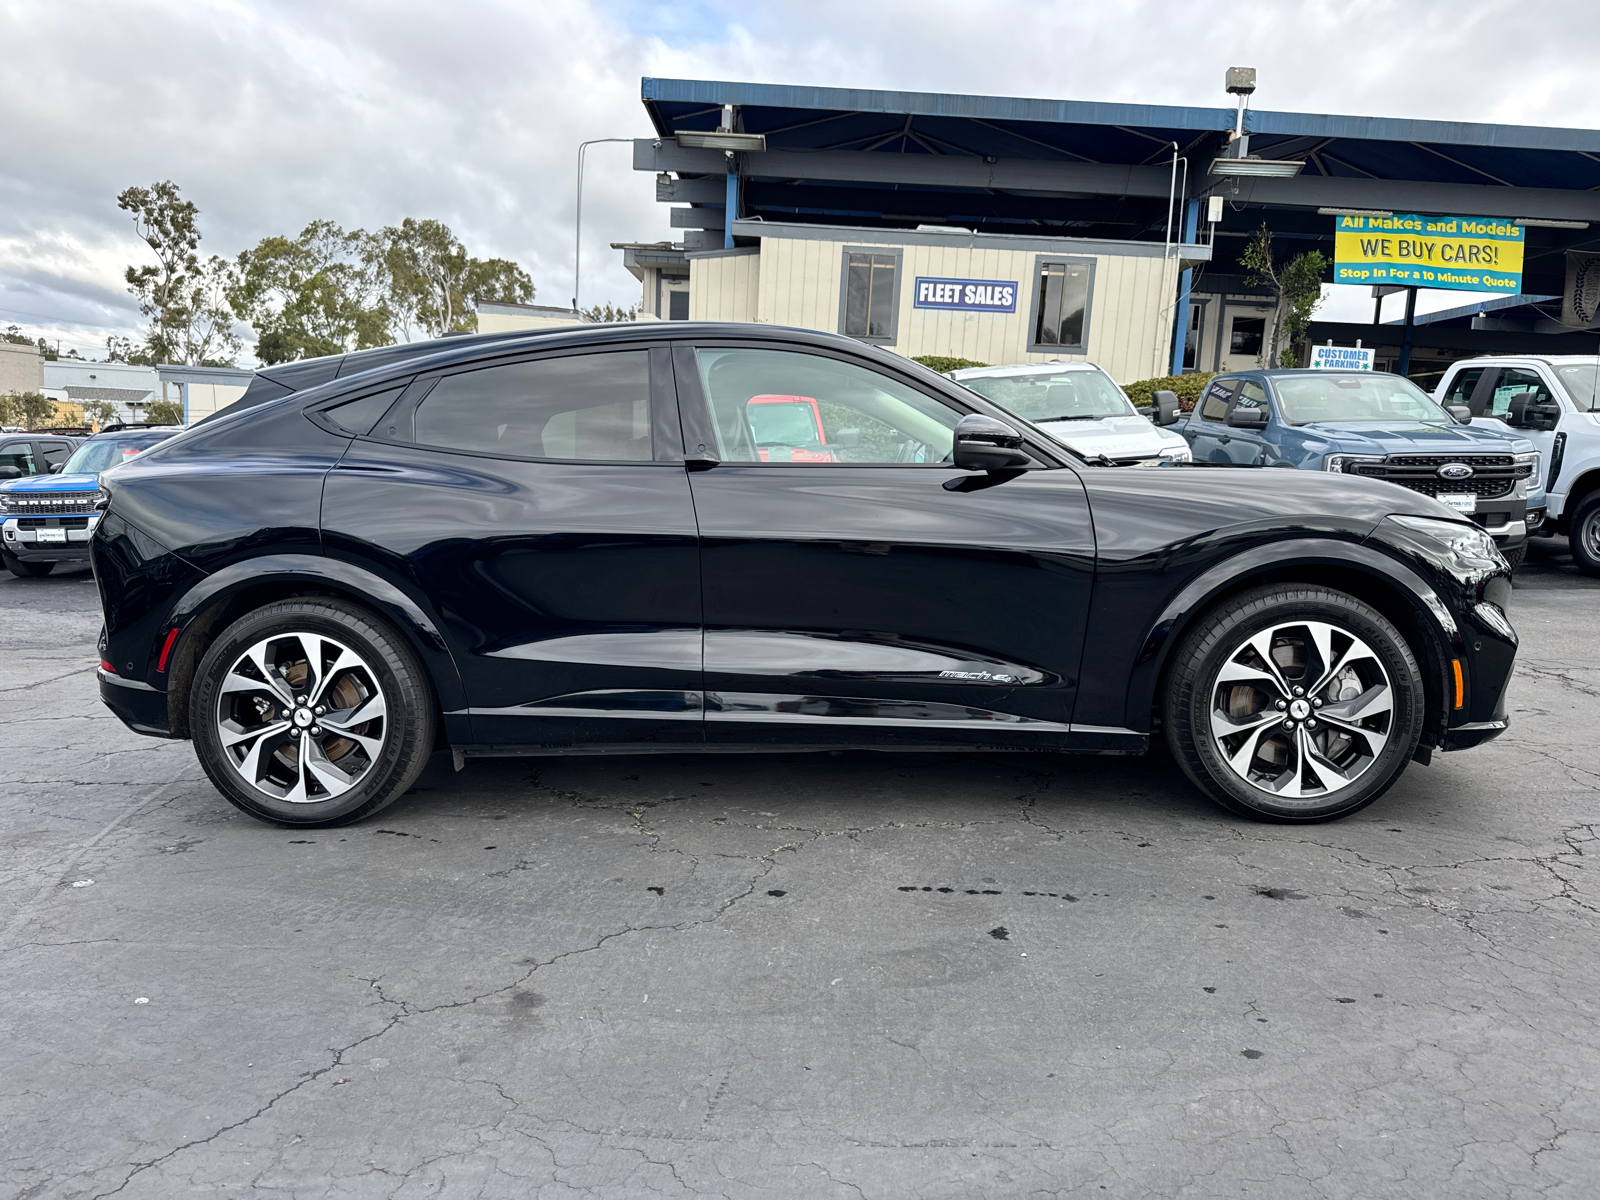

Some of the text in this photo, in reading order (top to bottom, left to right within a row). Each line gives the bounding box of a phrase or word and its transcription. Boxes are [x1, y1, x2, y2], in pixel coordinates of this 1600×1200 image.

[1341, 216, 1520, 236] All Makes and Models
[1360, 239, 1499, 265] WE BUY CARS!
[1340, 268, 1516, 287] Stop In For a 10 Minute Quote
[919, 283, 1013, 306] FLEET SALES
[1318, 348, 1369, 361] CUSTOMER
[1324, 359, 1360, 369] PARKING
[1364, 626, 1407, 682] MICHELIN
[201, 681, 212, 745] MICHELIN
